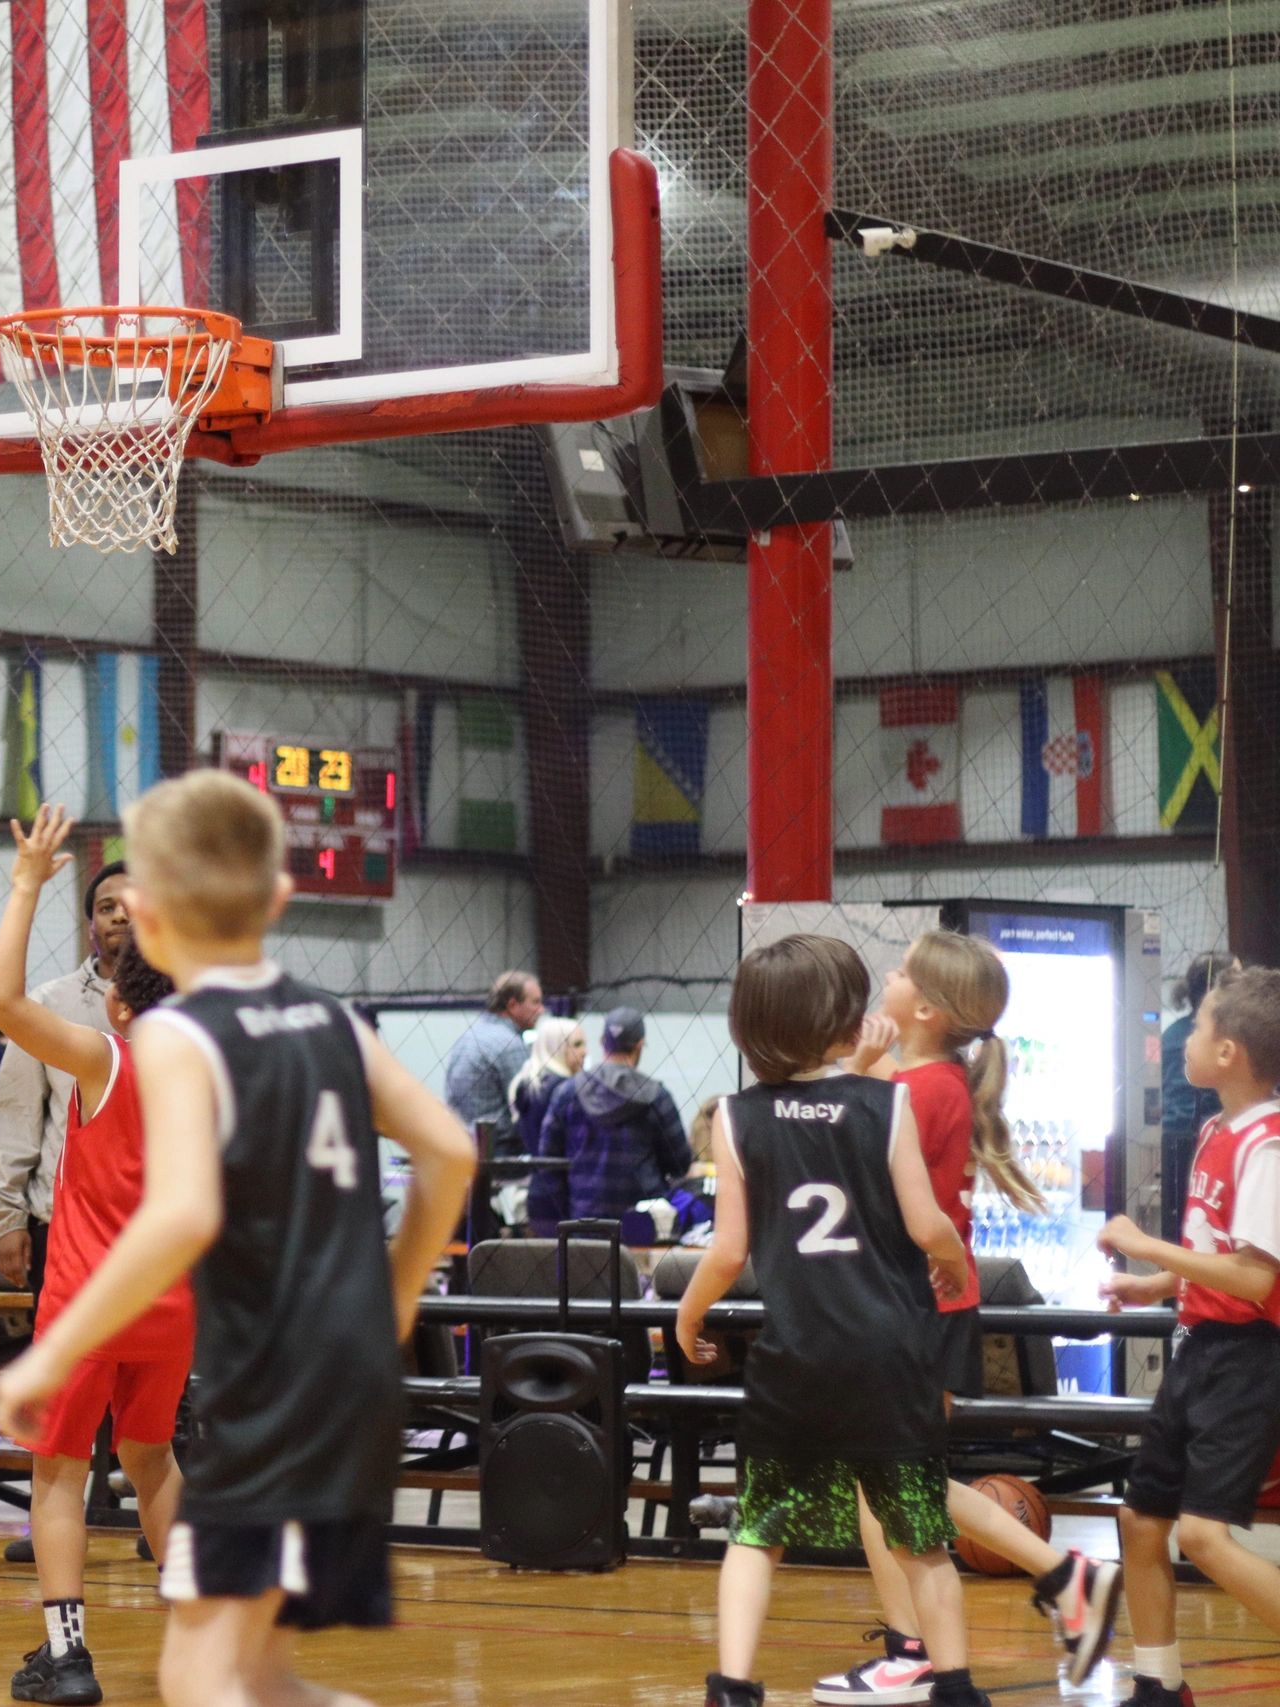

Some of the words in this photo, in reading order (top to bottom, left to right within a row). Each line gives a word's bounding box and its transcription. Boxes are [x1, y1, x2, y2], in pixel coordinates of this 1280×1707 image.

[306, 1088, 358, 1190] 4
[774, 1099, 845, 1123] Macy
[786, 1183, 860, 1254] 2
